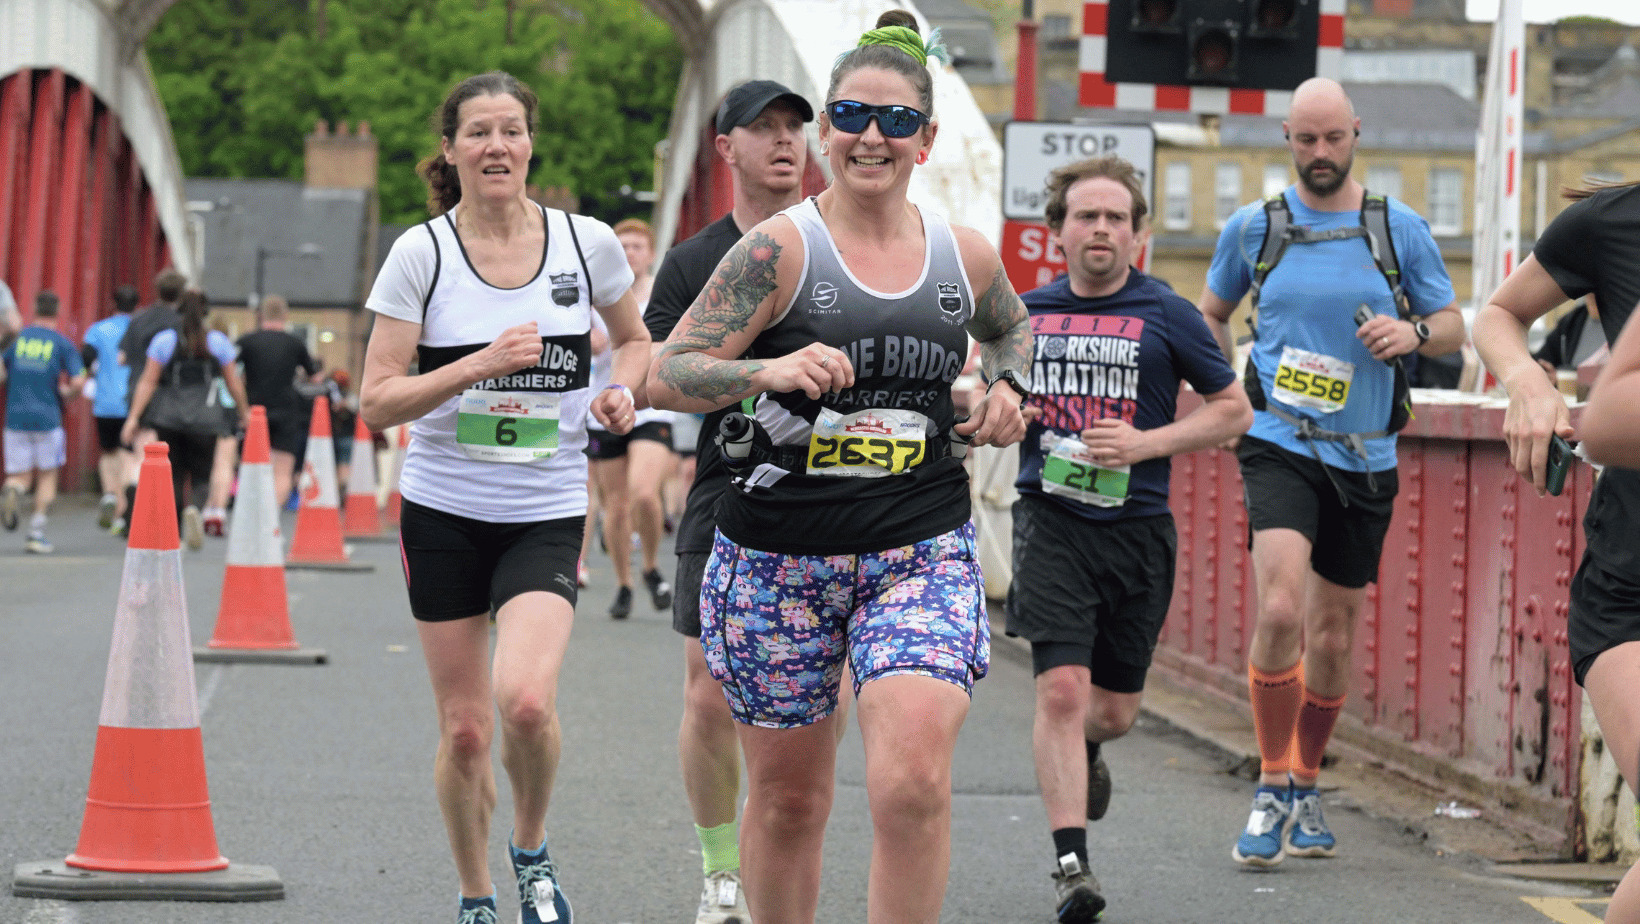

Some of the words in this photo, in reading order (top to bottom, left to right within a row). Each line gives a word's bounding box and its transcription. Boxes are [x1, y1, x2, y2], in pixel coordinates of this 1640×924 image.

[1042, 133, 1119, 155] STOP
[1027, 362, 1139, 400] ARATHON
[1277, 365, 1346, 401] 2558
[496, 417, 518, 446] 6
[812, 437, 921, 472] 2637
[1064, 462, 1099, 493] 21
